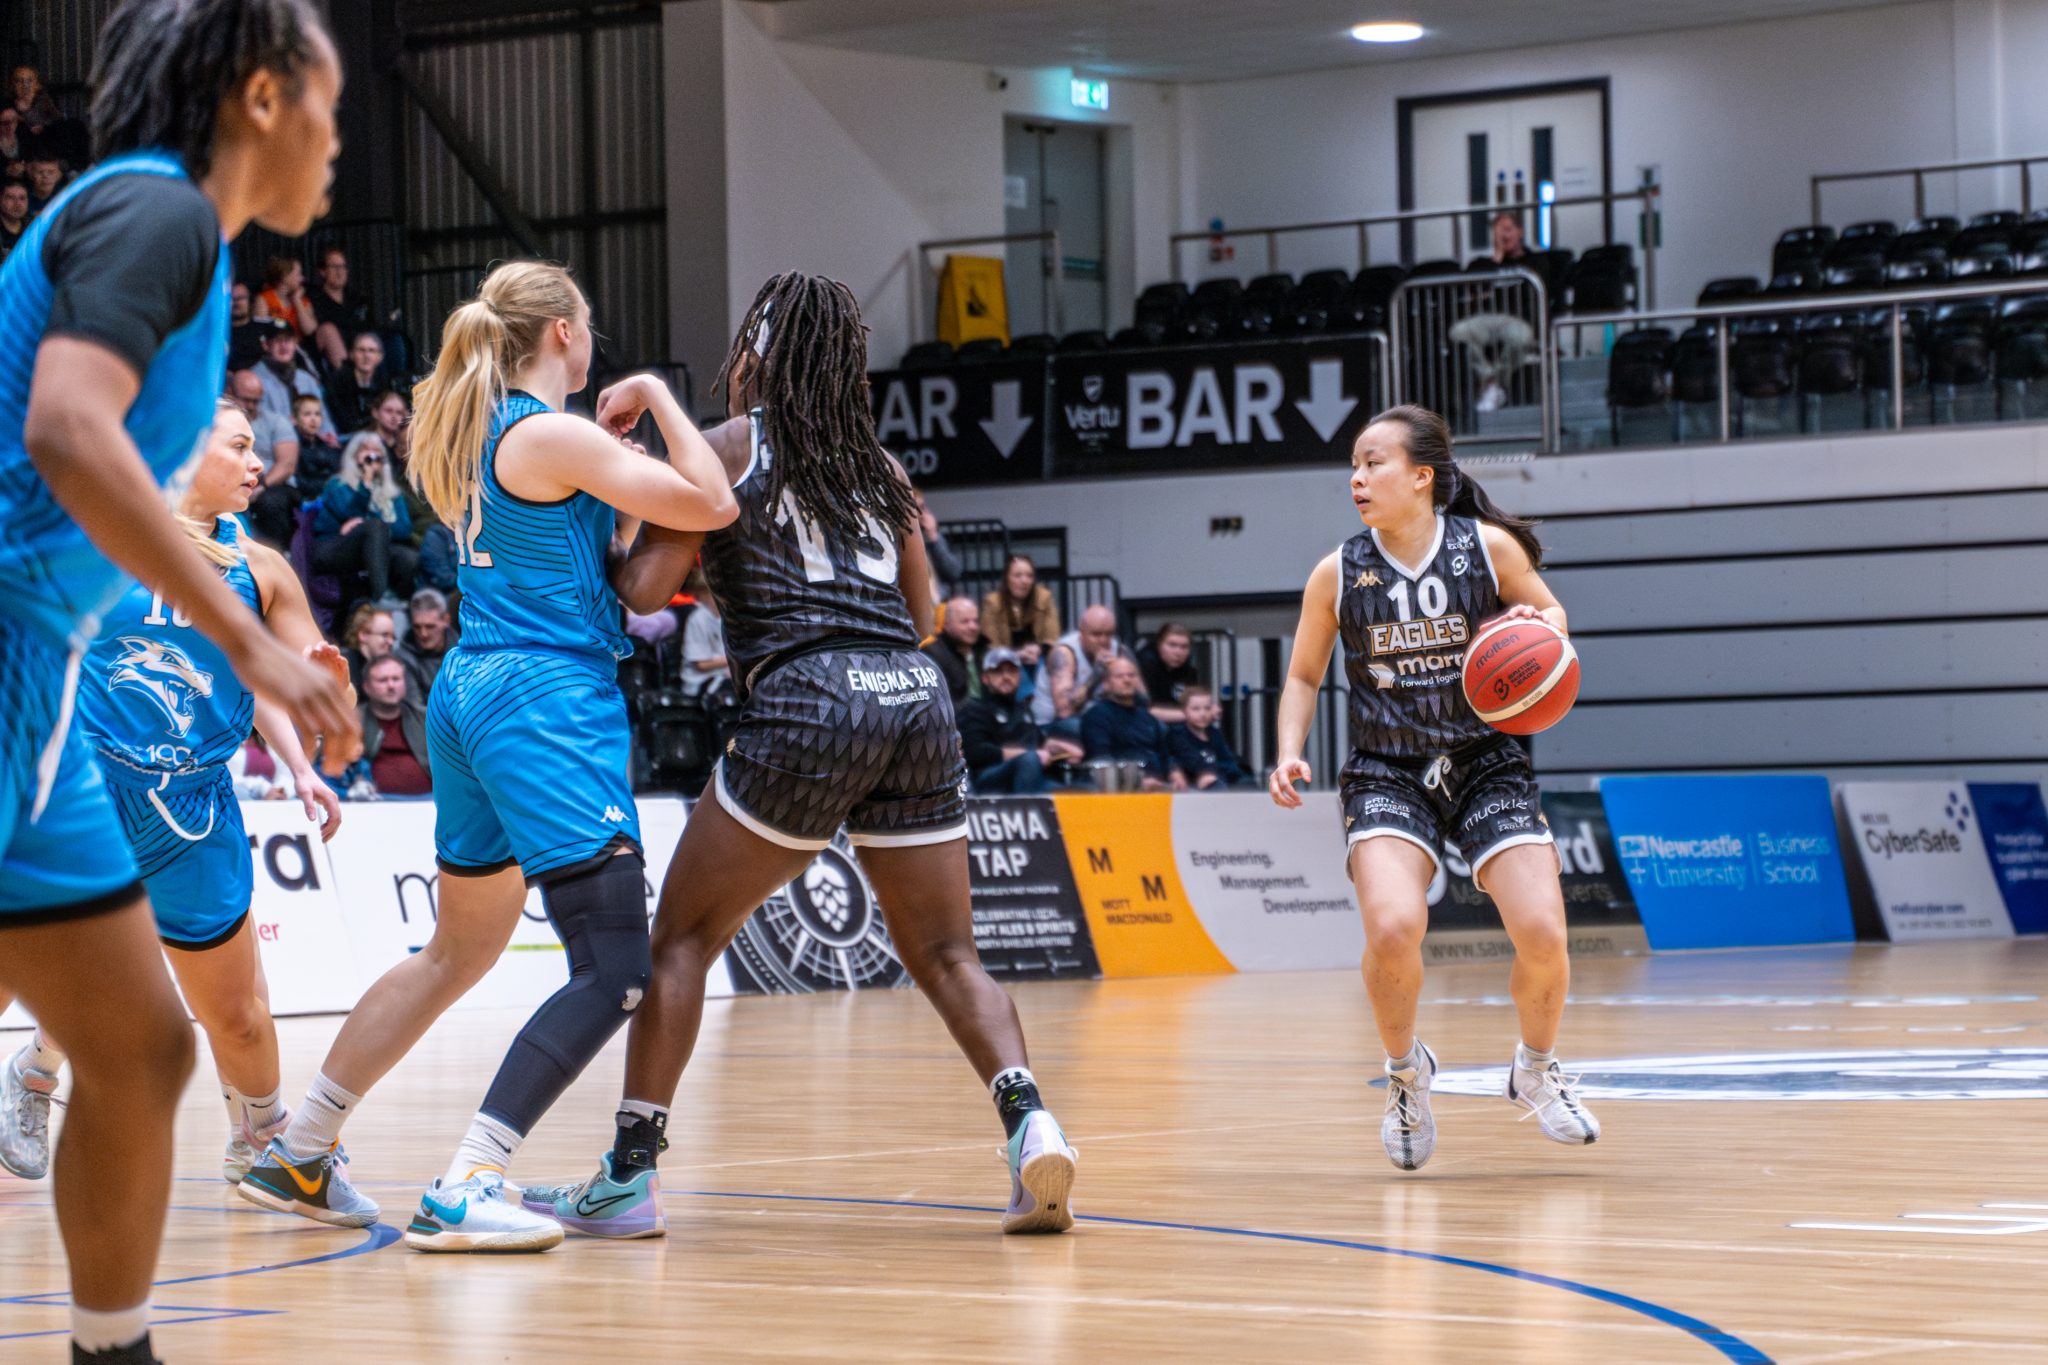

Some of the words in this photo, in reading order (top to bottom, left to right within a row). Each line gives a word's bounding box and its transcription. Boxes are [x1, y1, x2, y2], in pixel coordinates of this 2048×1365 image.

[872, 377, 957, 442] AR
[1065, 402, 1121, 430] Vertu
[1127, 367, 1284, 449] BAR
[903, 449, 939, 474] OD
[1387, 576, 1448, 623] 10
[1373, 616, 1468, 653] EAGLES
[1476, 633, 1519, 670] molten
[847, 669, 914, 693] ENIGMA
[909, 667, 938, 688] TAP
[1401, 676, 1434, 689] Forward
[1434, 671, 1463, 684] Togeth
[878, 695, 900, 706] NORTH
[900, 690, 930, 703] SHIELDS
[1650, 836, 1743, 859] Newcastle
[1758, 832, 1830, 855] Business
[1865, 828, 1961, 860] CyberSafe
[970, 849, 1029, 877] TAP
[1087, 847, 1113, 874] M
[1190, 850, 1274, 869] Engineering.
[1141, 874, 1167, 901] M
[1219, 875, 1310, 893] Management.
[1653, 861, 1746, 890] University
[1762, 860, 1820, 884] School
[1102, 899, 1130, 909] MOTT
[1262, 898, 1355, 915] Development.
[972, 923, 997, 936] RAFT
[1106, 913, 1173, 925] MACDONALD
